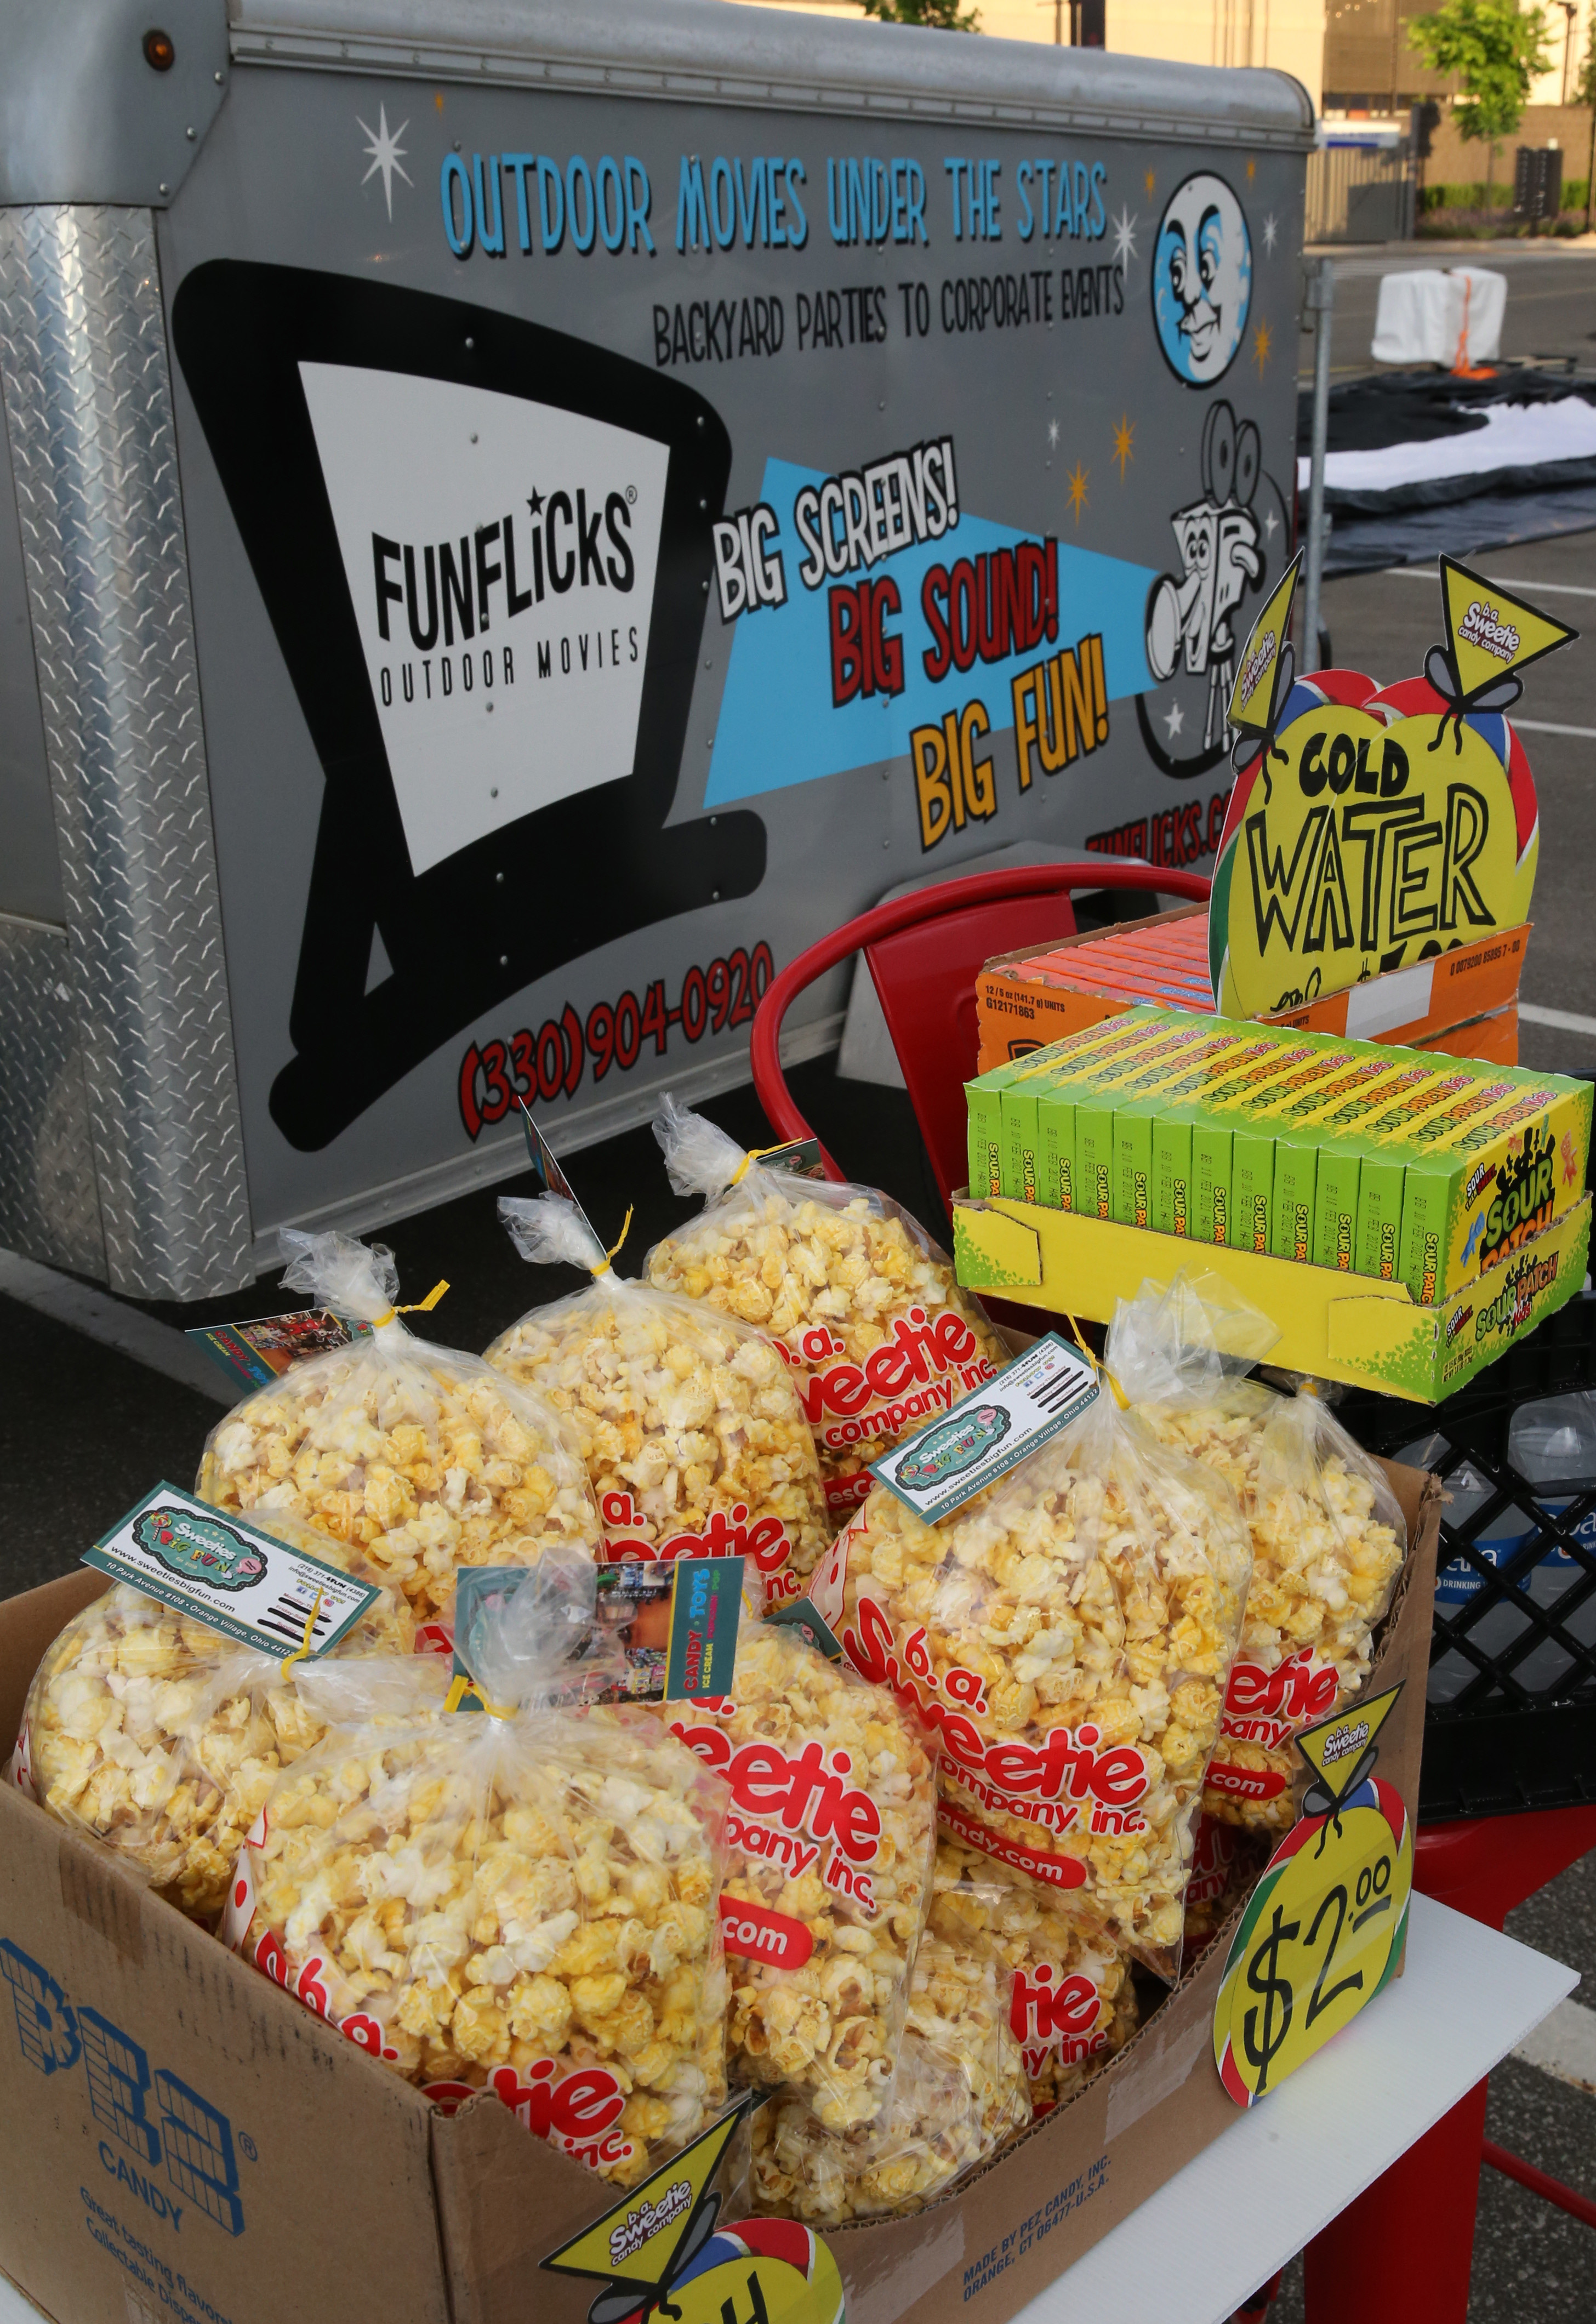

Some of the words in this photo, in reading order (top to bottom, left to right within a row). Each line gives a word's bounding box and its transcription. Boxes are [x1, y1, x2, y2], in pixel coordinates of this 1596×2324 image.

[440, 152, 657, 260] OUTDOOR
[674, 154, 808, 255] MOVIES
[827, 157, 929, 248] UNDER
[943, 157, 1001, 242] THE
[1017, 160, 1107, 243] STARS
[652, 296, 785, 366] BACKYARD
[796, 285, 887, 351] PARTIES
[899, 282, 930, 338] TO
[941, 271, 1053, 334] CORPORATE
[1061, 264, 1125, 320] EVENTS
[711, 502, 788, 625] BIG
[794, 435, 959, 590] SCREENS!
[828, 576, 905, 708] BIG
[921, 537, 1059, 682] SOUND!
[1463, 601, 1520, 651] Sweetie
[1482, 601, 1499, 622] b.a.
[1458, 625, 1481, 647] candy
[1481, 637, 1515, 664] company
[380, 646, 514, 707] OUTDOOR
[537, 626, 638, 679] MOVIES
[909, 698, 997, 853] BIG
[1011, 633, 1109, 794] FUN!
[1299, 733, 1410, 797] COLD
[1245, 783, 1496, 957] WATER
[986, 985, 994, 994] 12
[999, 988, 1004, 997] 5
[1006, 991, 1013, 999] oz
[1014, 992, 1035, 1005] (141.7
[1036, 998, 1043, 1009] g)
[1044, 999, 1065, 1012] UNITS
[987, 997, 1035, 1019] G12171863
[458, 941, 774, 1143] (330)904-0920
[1013, 1047, 1068, 1069] SOUR
[1053, 1029, 1110, 1051] PATCH
[1051, 1054, 1106, 1075] SOUR
[1091, 1035, 1148, 1057] PATCH
[1088, 1061, 1143, 1083] SOUR
[1126, 1042, 1183, 1063] PATCH
[1163, 1073, 1218, 1095] SOUR
[1200, 1053, 1258, 1076] PATCH
[1241, 1085, 1296, 1109] SOUR
[1277, 1066, 1334, 1089] PATCH
[1323, 1100, 1377, 1124] SOUR
[1358, 1080, 1415, 1104] PATCH
[1408, 1117, 1462, 1142] SOUR
[1441, 1095, 1497, 1121] PATCH
[1452, 1126, 1504, 1150] SOUR
[1485, 1103, 1539, 1129] PATCH
[988, 1142, 1000, 1180] SOUR
[1023, 1149, 1035, 1187] SOUR
[1059, 1158, 1071, 1195] SOUR
[1466, 1161, 1485, 1198] SOUR
[1135, 1171, 1147, 1210] SOUR
[1213, 1186, 1226, 1225] SOUR
[1486, 1158, 1552, 1248] SOUR
[1295, 1204, 1308, 1243] SOUR
[1380, 1223, 1395, 1263] SOUR
[1423, 1232, 1439, 1273] SOUR
[1421, 1272, 1436, 1304] PATC
[1475, 1284, 1517, 1341] SOUR
[1517, 1250, 1560, 1307] PATCH
[1447, 1305, 1463, 1336] SOUR
[214, 1330, 250, 1362] CANDY
[999, 1375, 1012, 1386] (216)
[824, 1377, 953, 1449] company
[957, 1358, 998, 1391] inc.
[919, 1423, 976, 1464] Sweeties
[941, 1501, 950, 1511] 10
[950, 1491, 967, 1505] Park
[967, 1472, 993, 1491] Avenue
[992, 1460, 1010, 1474] #108
[1013, 1439, 1039, 1459] Orange
[1038, 1417, 1065, 1440] Village,
[1063, 1405, 1080, 1420] Ohio
[1080, 1388, 1099, 1406] 44122
[953, 1427, 987, 1456] FUN
[925, 1427, 1033, 1506] www.sweetiesbigfun.com
[174, 1522, 237, 1561] Sweeties
[190, 1549, 233, 1573] FUN
[111, 1546, 236, 1613] www.sweetiesbigfun.com
[298, 1563, 314, 1573] (216)
[313, 1569, 347, 1590] 371-4FUN
[346, 1586, 366, 1599] (4386)
[689, 1568, 710, 1618] TOYS
[1443, 1579, 1481, 1590] DRINKING
[106, 1561, 115, 1570] 10
[115, 1566, 135, 1580] Park
[134, 1577, 164, 1596] Avenue
[164, 1592, 185, 1606] #108
[190, 1604, 219, 1624] Orange
[220, 1617, 248, 1639] Village,
[250, 1633, 271, 1648] Ohio
[272, 1643, 295, 1659] 44122
[276, 1621, 298, 1634] Sunday
[683, 1630, 703, 1691] CANDY
[704, 1643, 714, 1673] CREAM
[904, 1627, 987, 1714] b.a.
[702, 1674, 711, 1689] ICE
[1321, 1750, 1340, 1767] candy
[1341, 1736, 1369, 1756] company
[1324, 1721, 1370, 1757] Sweetie
[941, 1756, 1078, 1834] ompany
[1092, 1801, 1147, 1834] inc.
[828, 1847, 875, 1908] inc.
[98, 2139, 184, 2235] CANDY
[609, 2180, 692, 2257] Sweetie
[610, 2236, 644, 2268] candy
[647, 2194, 693, 2238] company
[628, 2200, 653, 2225] b.a.
[963, 2245, 998, 2286] MADE
[1001, 2230, 1018, 2254] BY
[1020, 2208, 1043, 2240] PEZ
[1045, 2174, 1084, 2218] CANDY,
[1088, 2154, 1112, 2181] INC.
[81, 2186, 120, 2236] Great
[122, 2224, 175, 2289] tasting
[86, 2216, 156, 2294] Collectable
[963, 2251, 1016, 2303] ORANGE,
[1019, 2232, 1035, 2256] CT
[1036, 2173, 1110, 2241] 06477-U.S.A.
